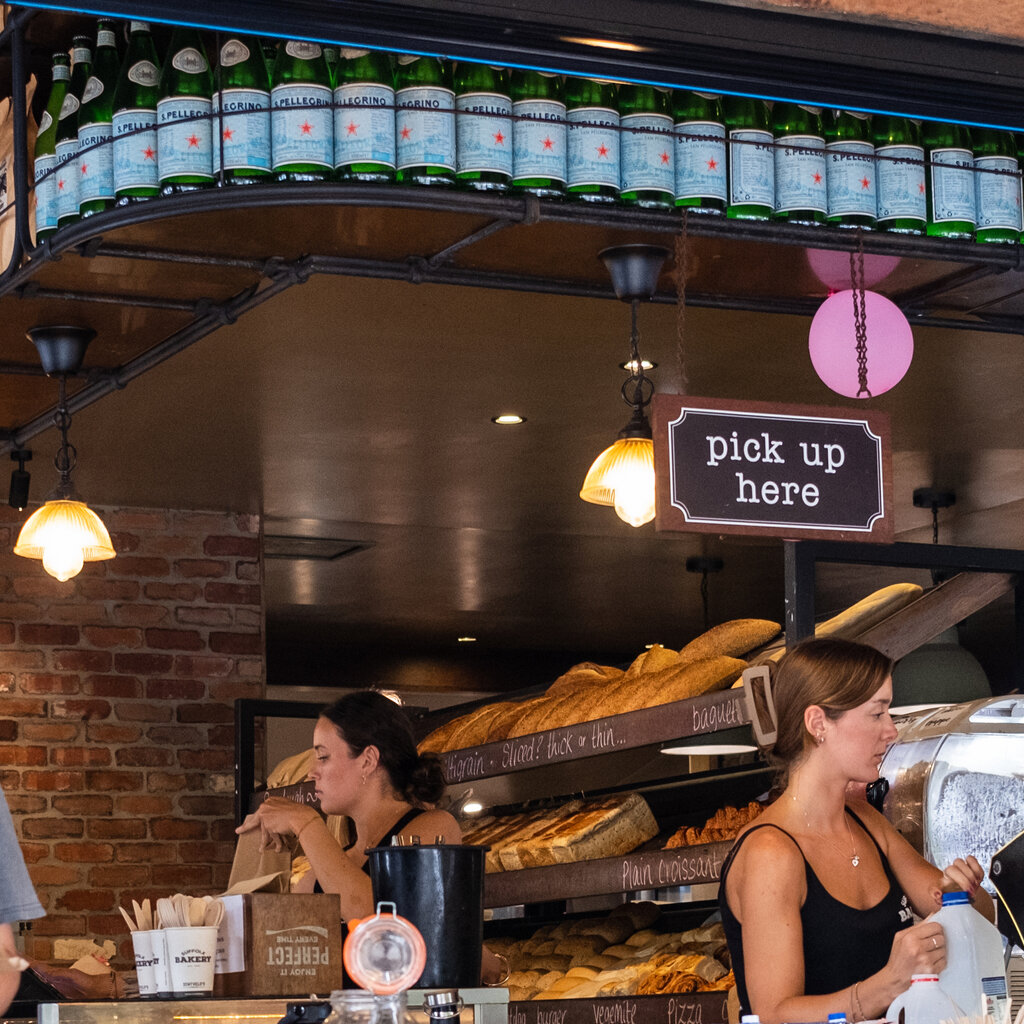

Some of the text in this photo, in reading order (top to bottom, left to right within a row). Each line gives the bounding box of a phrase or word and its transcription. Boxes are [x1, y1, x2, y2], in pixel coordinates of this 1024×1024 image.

[706, 431, 845, 474] pick up
[735, 472, 820, 507] here
[547, 731, 573, 759] thick
[578, 735, 587, 747] or
[622, 857, 653, 889] Plain
[174, 956, 212, 964] BAKERY
[266, 946, 329, 966] PERFECT
